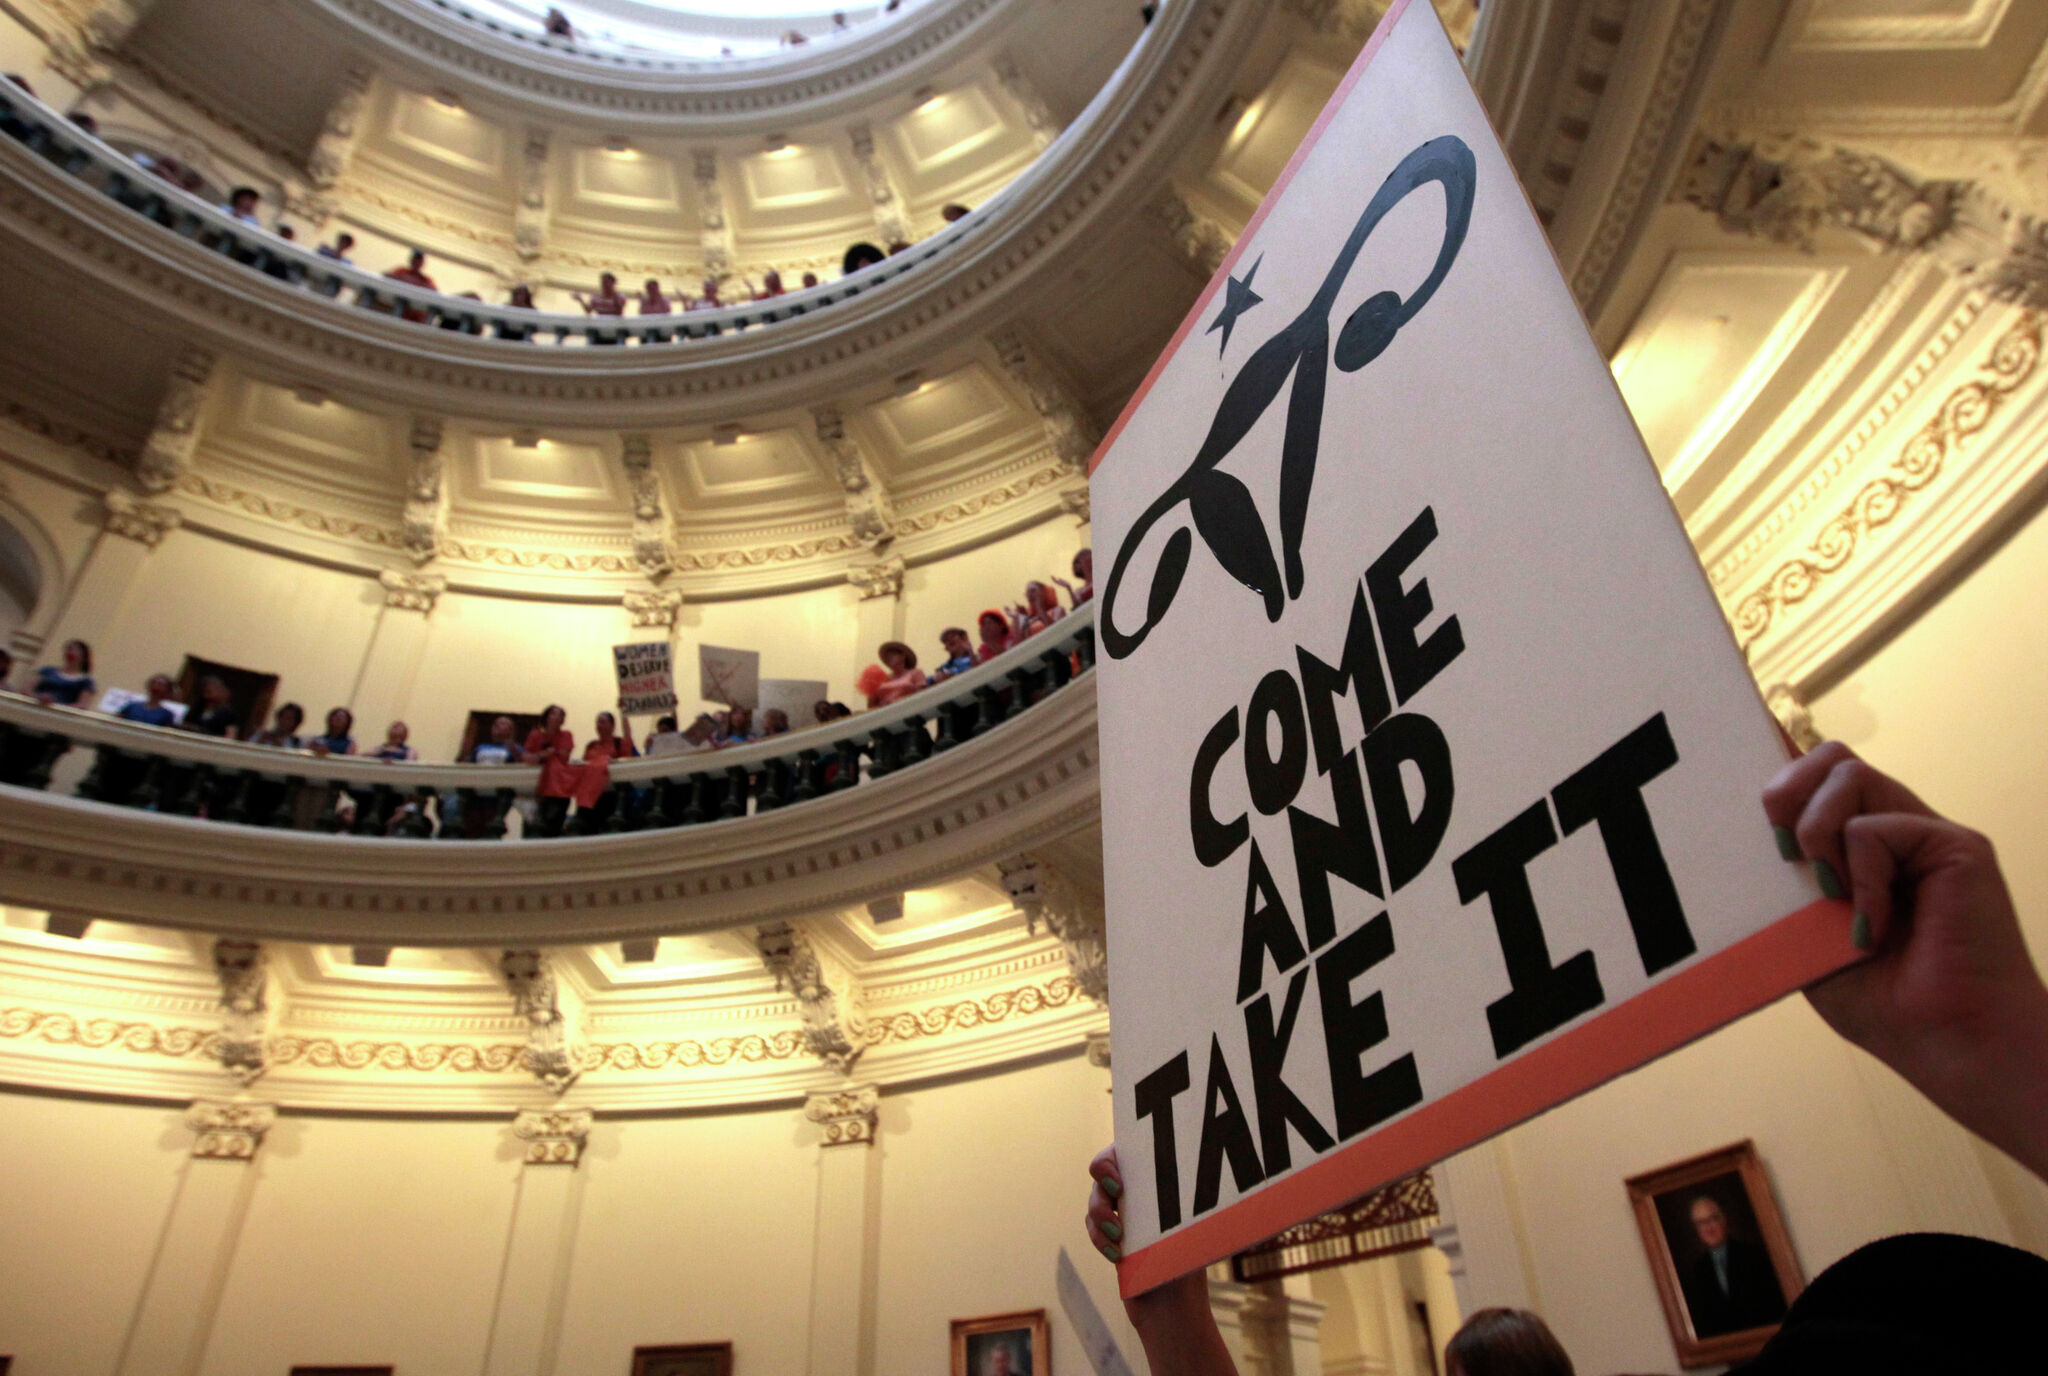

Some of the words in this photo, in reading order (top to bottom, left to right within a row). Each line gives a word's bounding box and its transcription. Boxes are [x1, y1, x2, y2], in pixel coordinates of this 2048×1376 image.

[615, 644, 668, 660] WOMEN
[618, 659, 670, 679] DESERVE
[1190, 505, 1466, 868] COME
[1134, 909, 1424, 1234] TAKE
[1452, 711, 1698, 1060] IT
[1236, 711, 1454, 1004] AND
